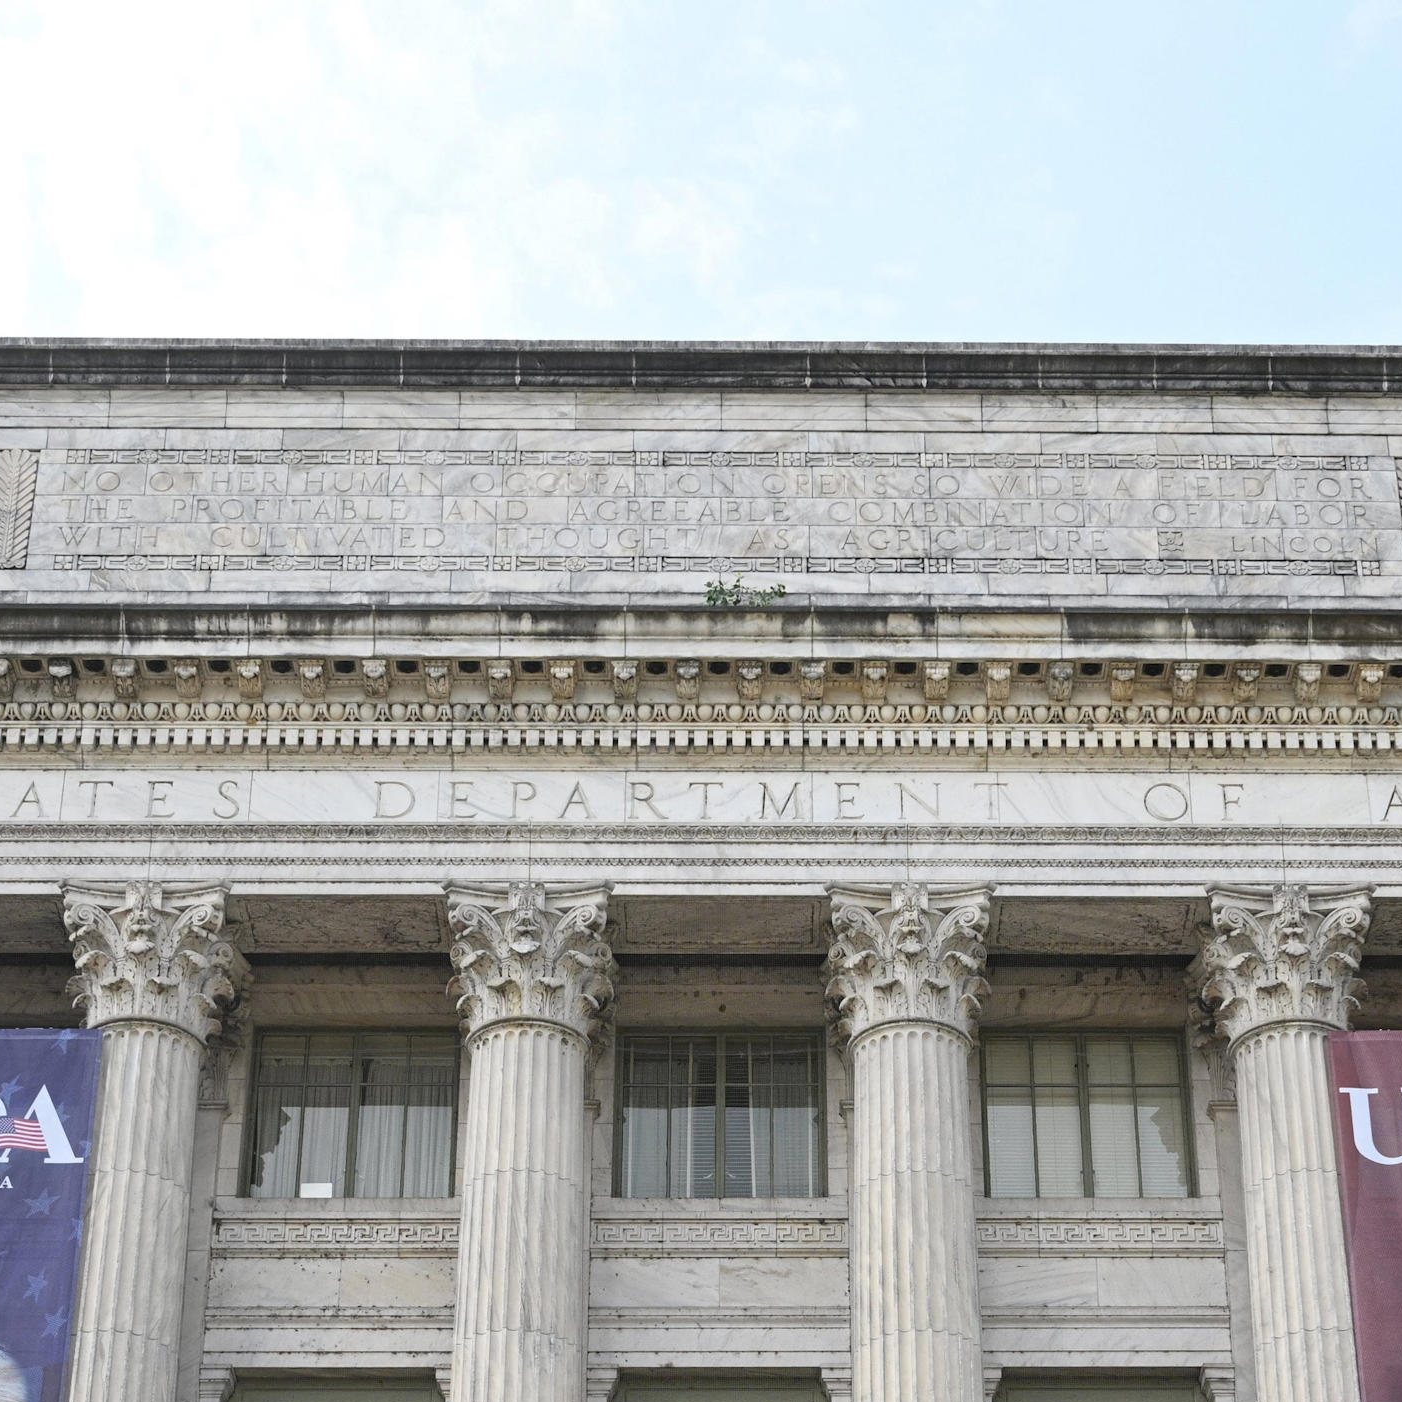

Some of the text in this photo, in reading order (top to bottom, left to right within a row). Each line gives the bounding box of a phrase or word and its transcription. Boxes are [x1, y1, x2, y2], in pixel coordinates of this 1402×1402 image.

[61, 471, 1372, 499] NO OTHER HUMAN OCCUPATION OPENS SO WIDE A FIELD FOR
[61, 499, 1378, 526] THE PROFITABLE AND AGREEABLE COMBINATION OF LABOR
[58, 526, 1380, 553] WITH CULTIVATED THOUGHT AS AGRICULTURE LINCOLN
[374, 780, 1015, 822] DEPARTMENT
[1143, 781, 1246, 823] OF
